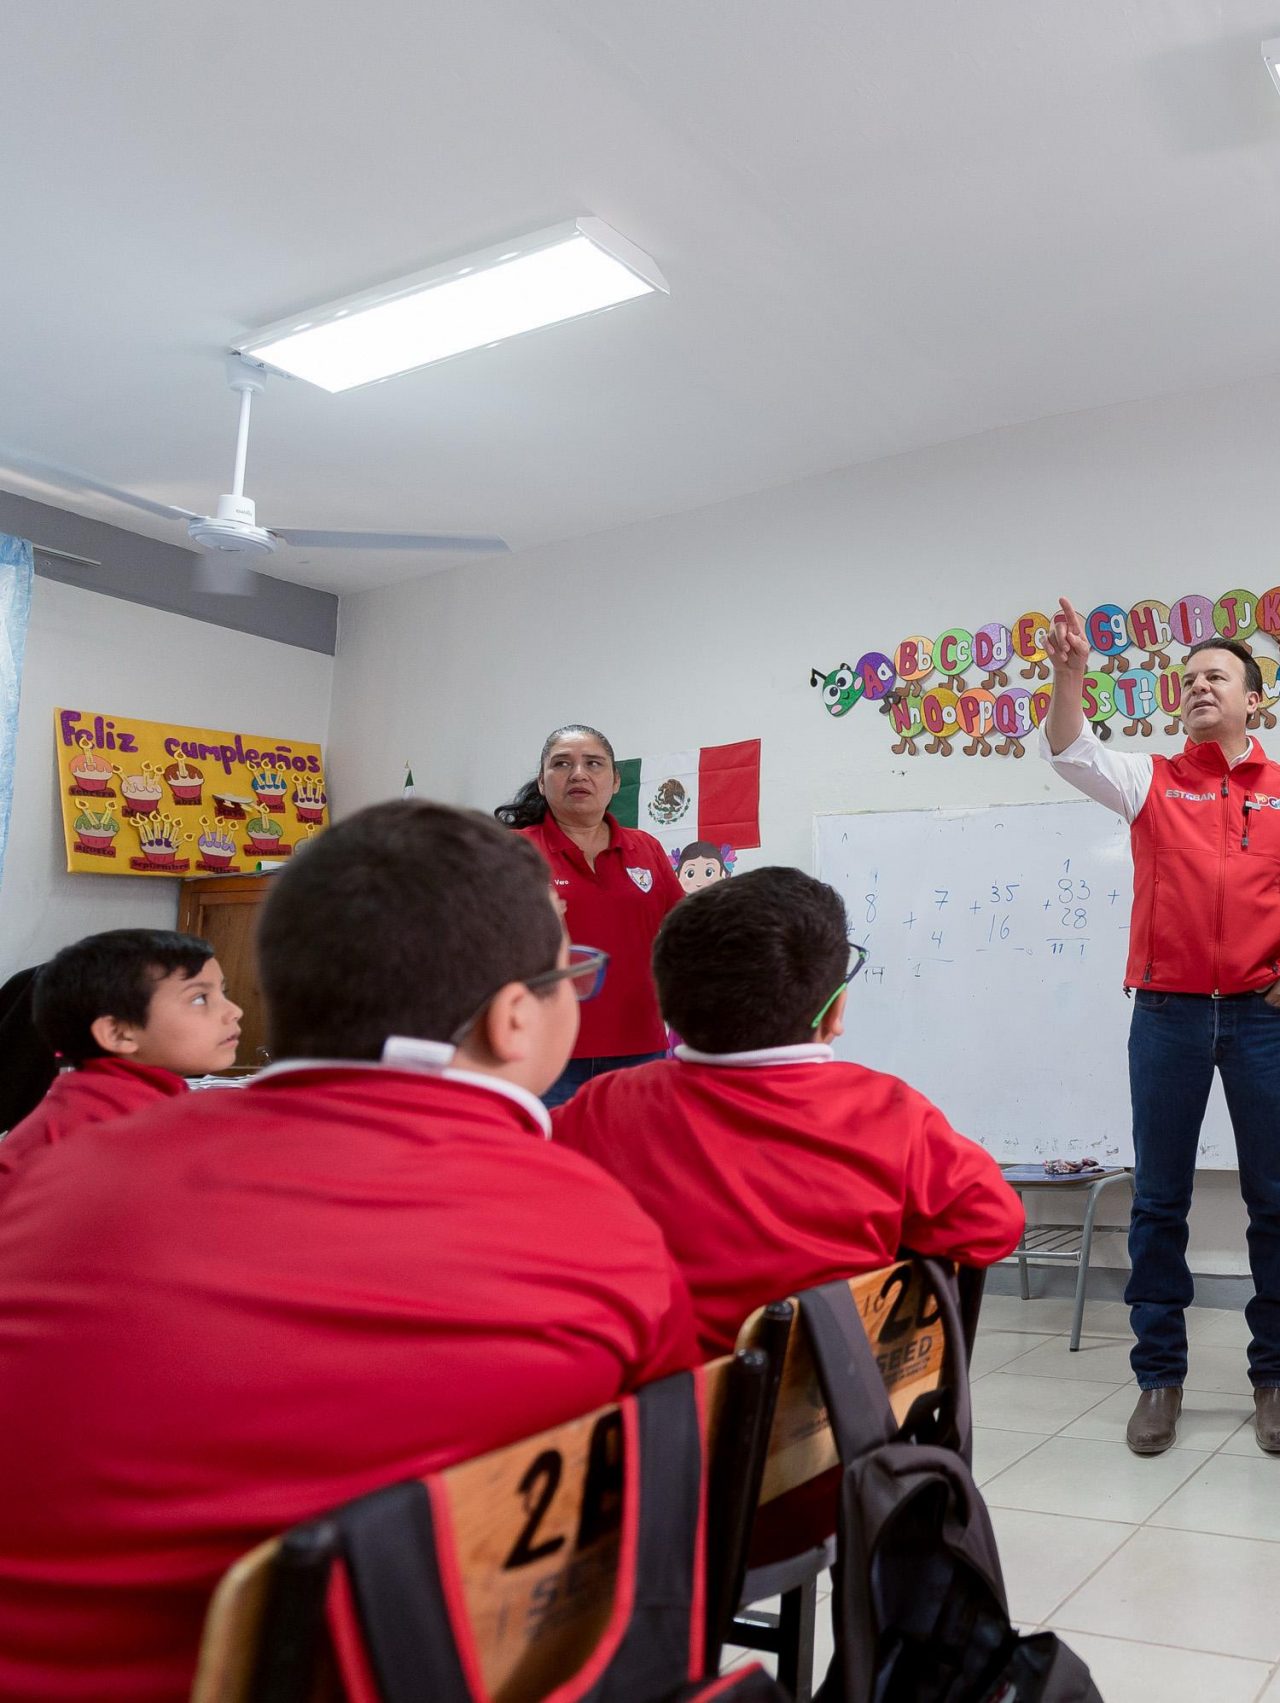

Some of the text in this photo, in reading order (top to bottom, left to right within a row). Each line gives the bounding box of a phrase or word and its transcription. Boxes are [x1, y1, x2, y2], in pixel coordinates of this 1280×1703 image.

[899, 639, 932, 676] Bb
[941, 635, 970, 670] Cc
[975, 623, 1009, 667] Dd
[1129, 607, 1171, 649] Hh
[889, 700, 921, 733] Nn
[60, 710, 321, 774] Feliz cumpleaños
[1165, 789, 1216, 801] ESTEBAN
[934, 890, 949, 911] 7
[990, 884, 1020, 903] 35
[865, 893, 876, 923] 8
[930, 930, 943, 949] 4
